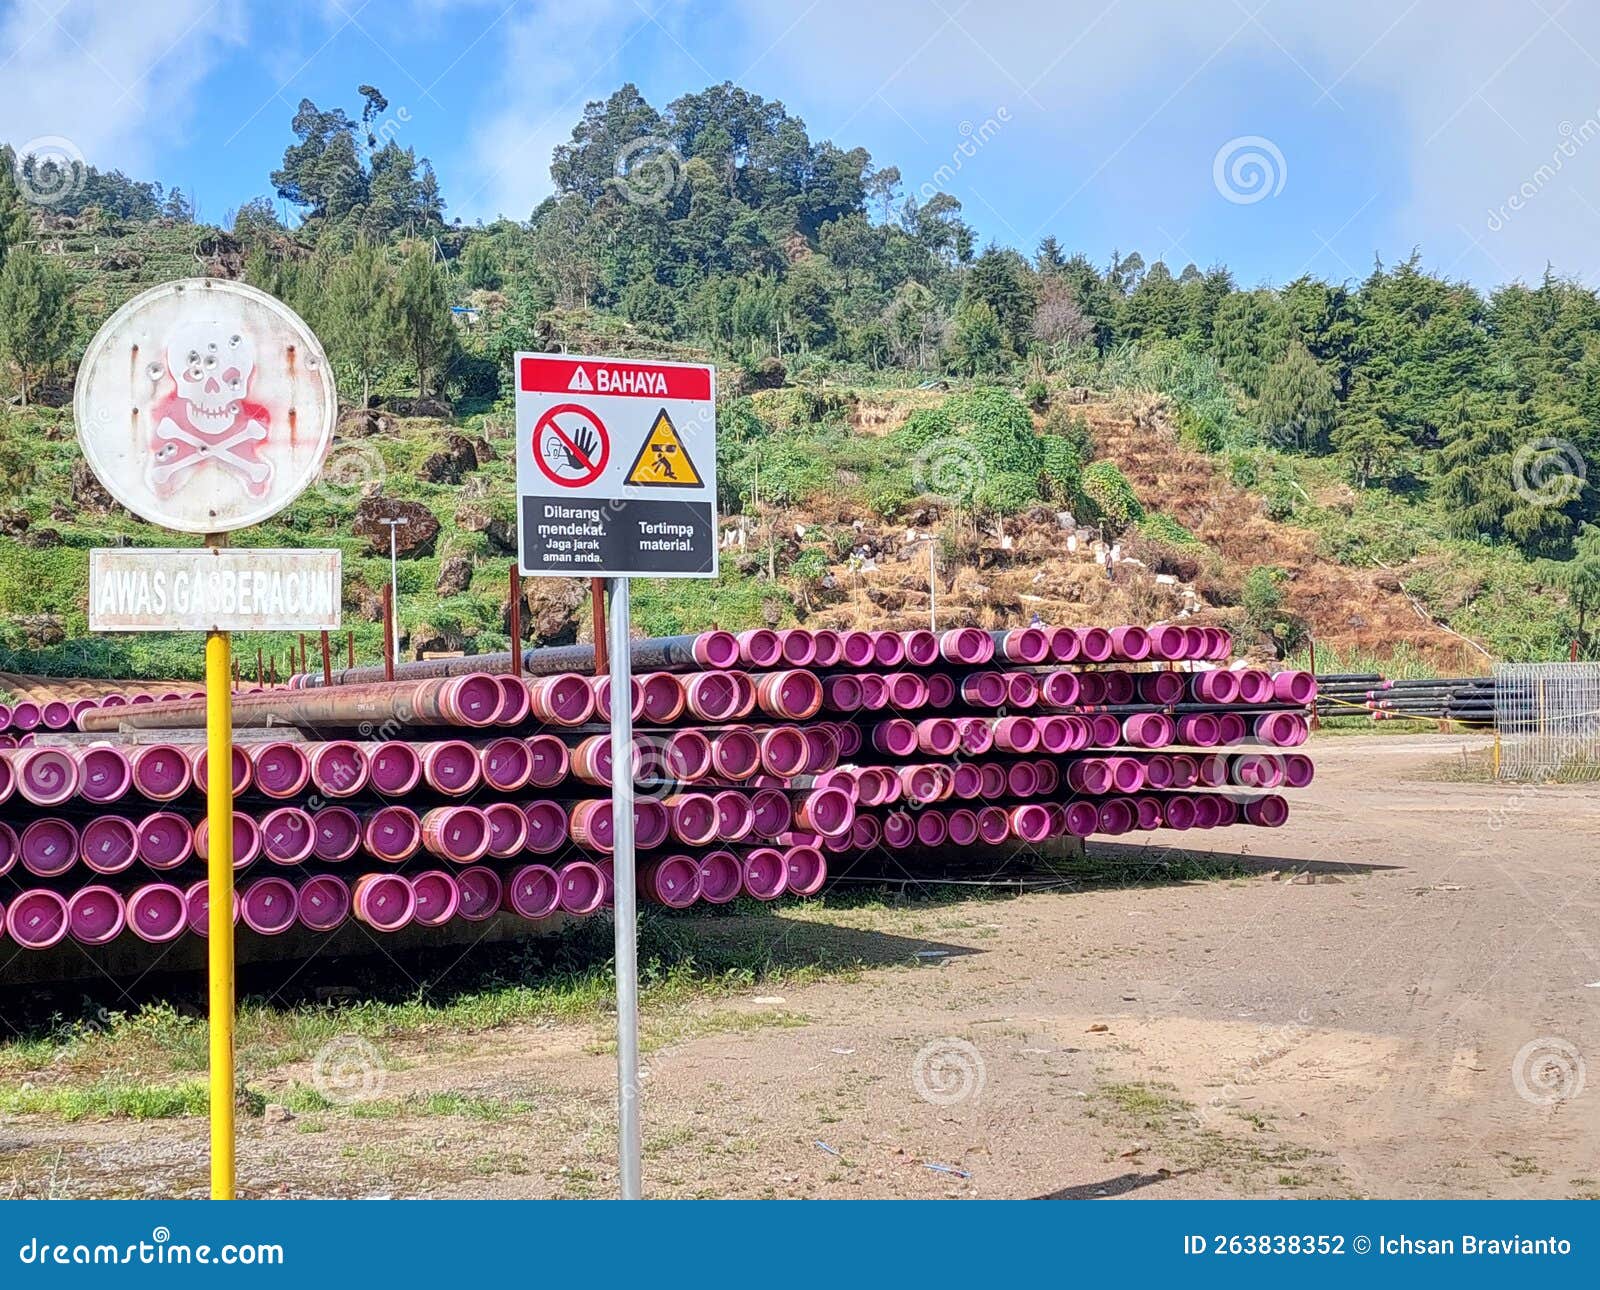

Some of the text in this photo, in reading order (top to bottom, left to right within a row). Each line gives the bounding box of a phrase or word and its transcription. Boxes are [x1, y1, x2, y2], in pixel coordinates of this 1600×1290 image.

[597, 369, 668, 394] BAHAYA
[544, 505, 600, 522] Dilarang
[538, 523, 607, 538] mendekat.
[638, 521, 694, 537] Tertimpa
[546, 539, 600, 551] Jaga jarak
[639, 539, 694, 551] material.
[543, 553, 603, 563] aman anda.
[99, 570, 166, 615] AWAS
